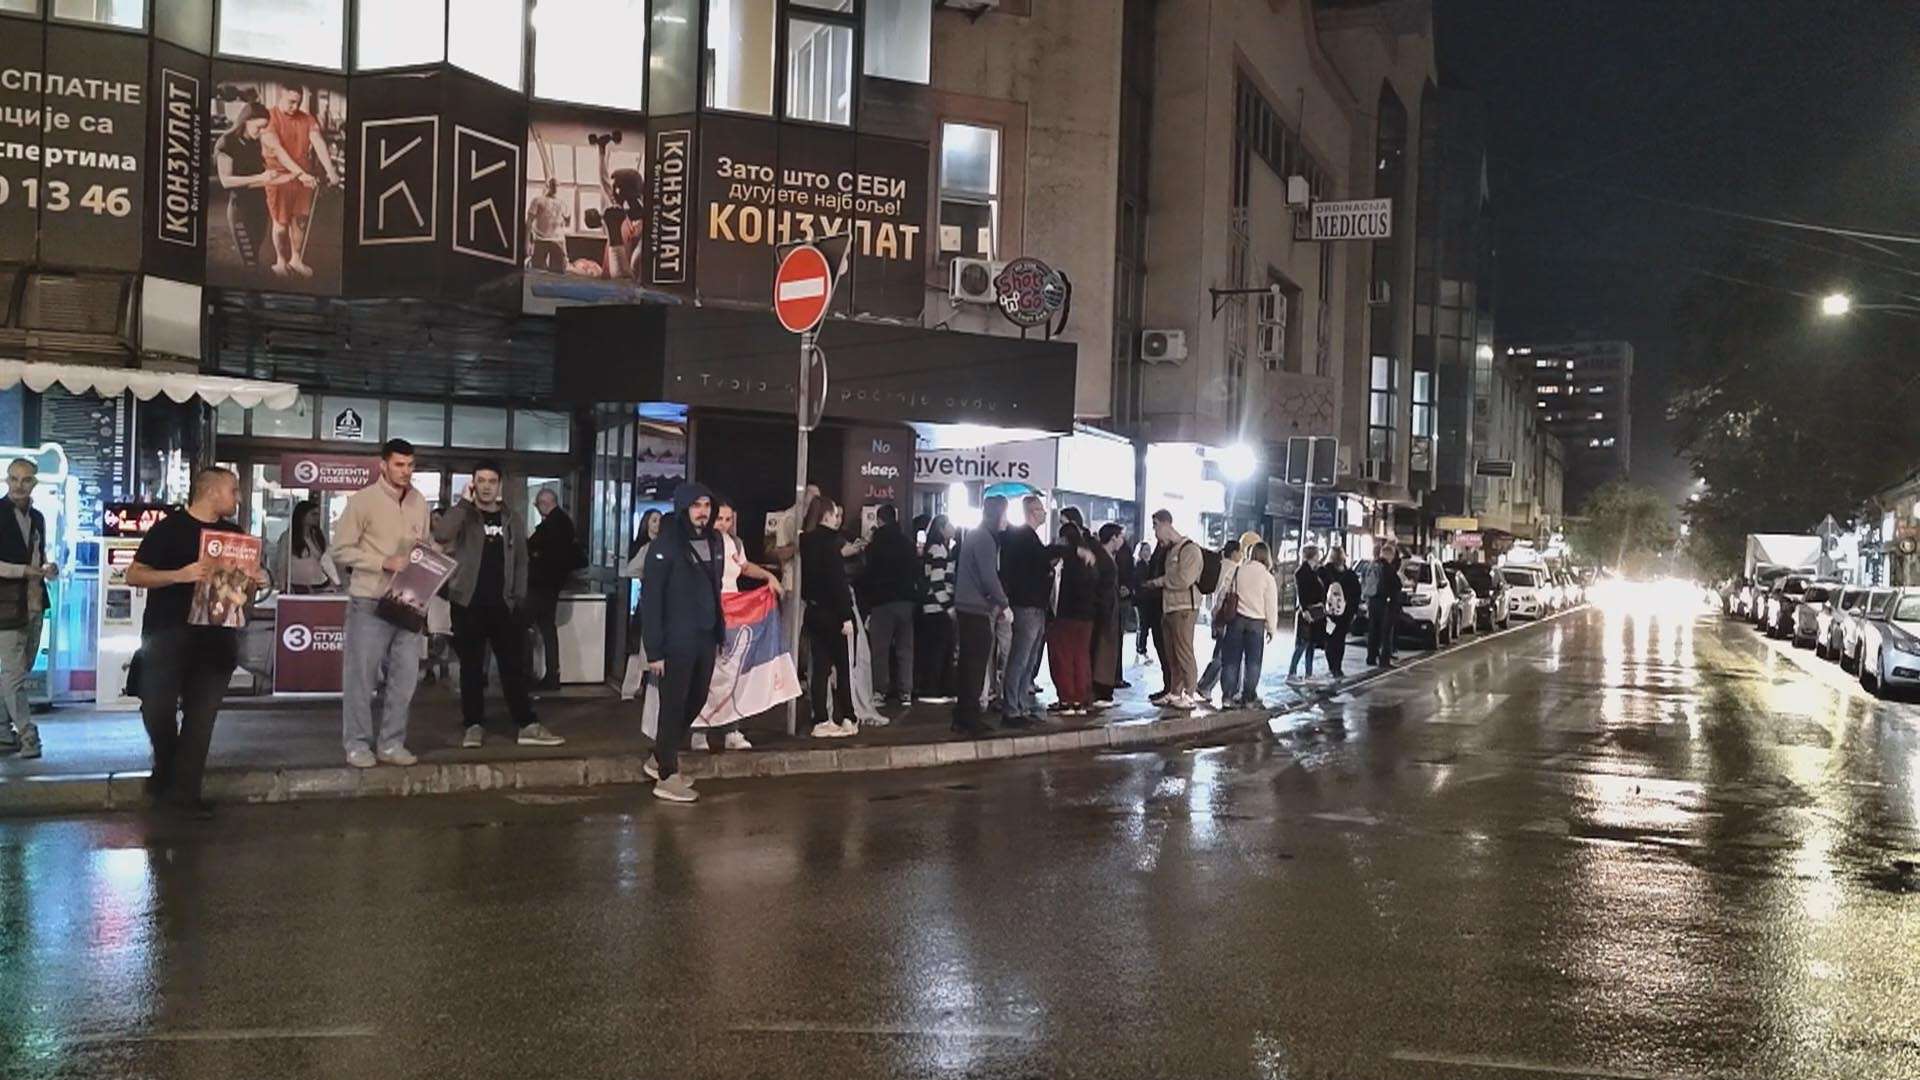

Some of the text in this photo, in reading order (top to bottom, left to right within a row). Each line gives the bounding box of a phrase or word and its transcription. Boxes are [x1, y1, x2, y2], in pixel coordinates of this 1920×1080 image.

[2, 69, 141, 104] СПЛАТНЕ
[0, 106, 114, 134] ције са
[0, 142, 137, 171] пертима
[166, 82, 192, 234] КОНЗУЛАТ
[717, 157, 906, 199] Зато што СЕБИ
[660, 140, 684, 272] КОНЗУЛАТ
[728, 182, 901, 216] дугујете најбоље!
[708, 202, 920, 261] КОНЗУЛАТ
[1315, 211, 1388, 237] MEDICUS
[872, 439, 891, 453] No
[319, 466, 370, 476] СТУДЕНТИ
[865, 485, 895, 499] Just
